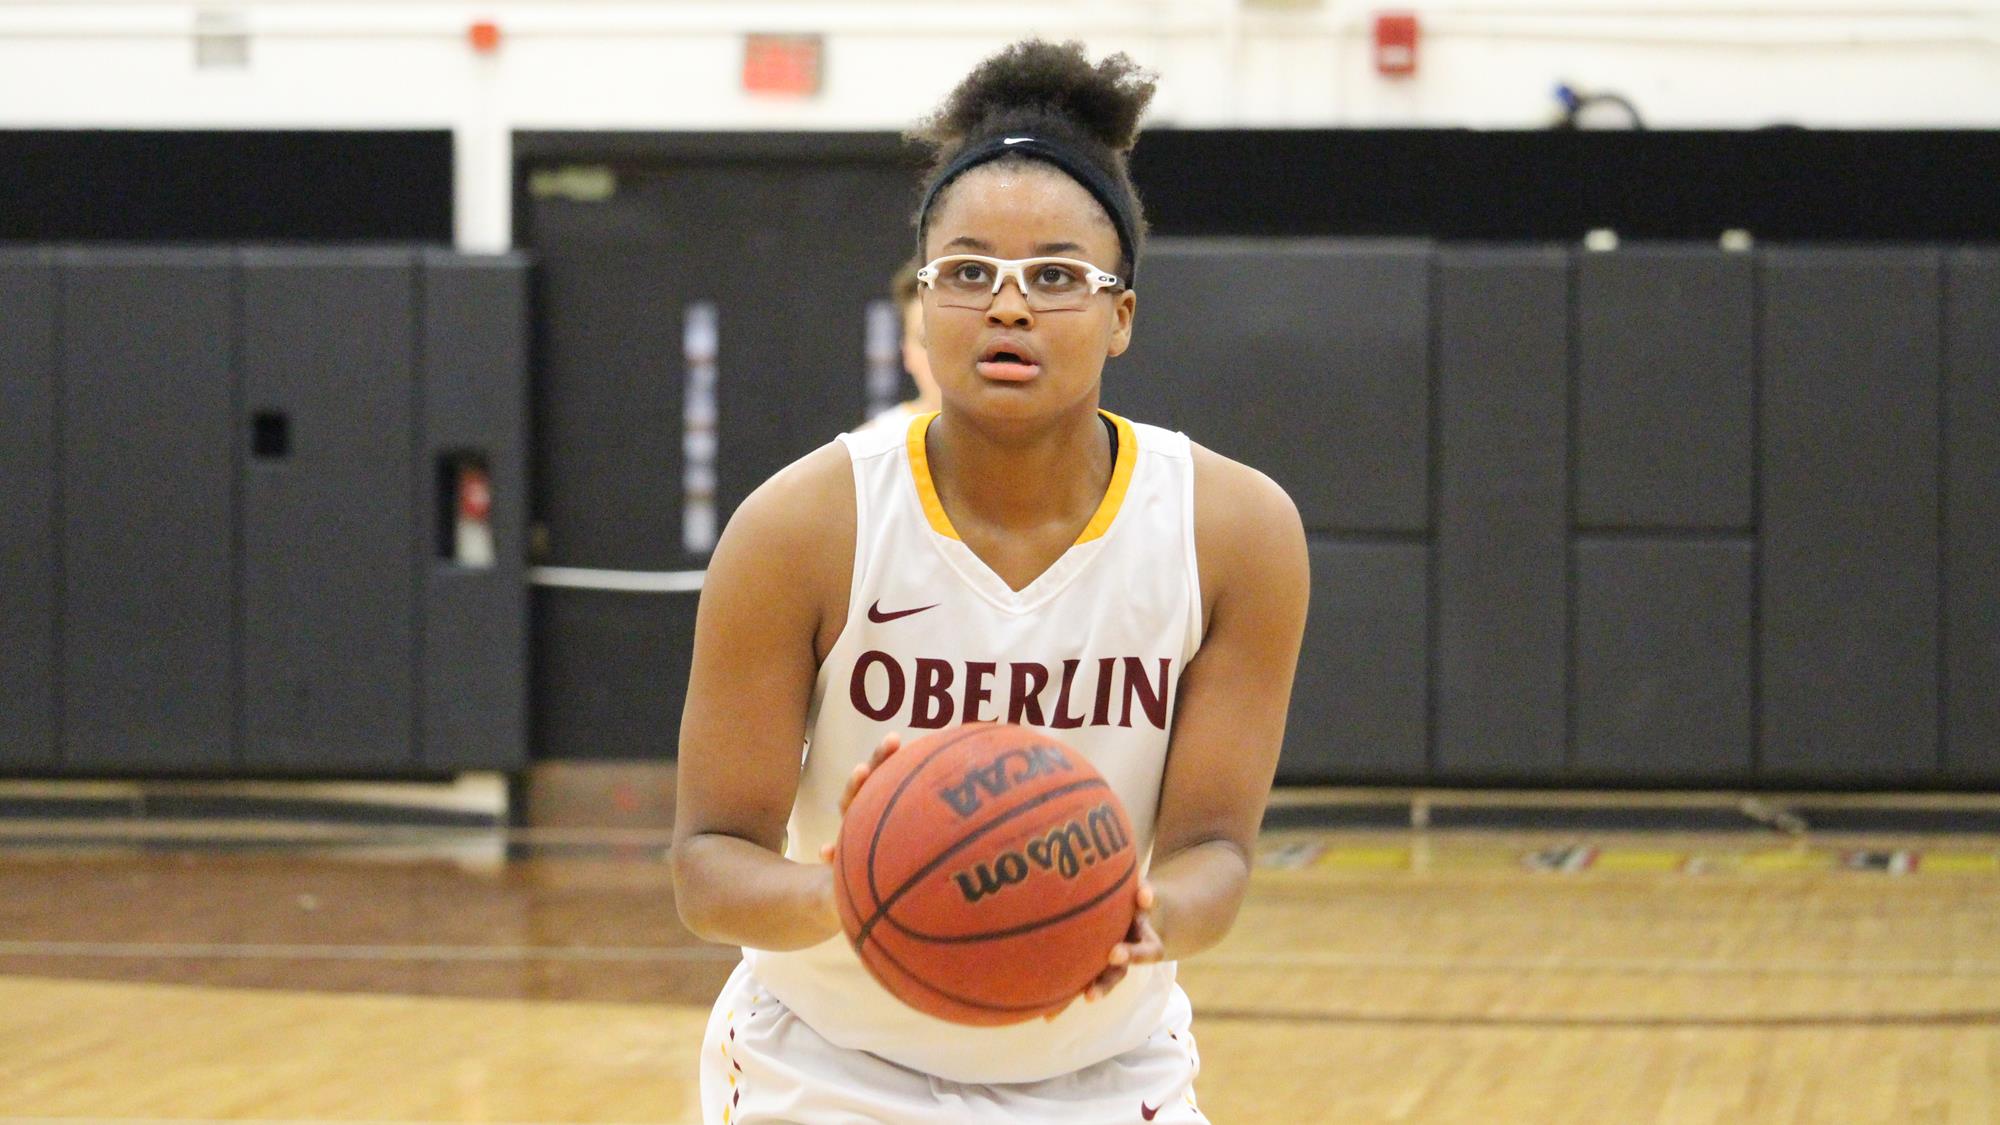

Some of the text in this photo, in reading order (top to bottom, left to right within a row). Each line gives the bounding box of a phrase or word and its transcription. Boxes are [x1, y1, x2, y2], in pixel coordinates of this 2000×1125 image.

[849, 650, 1172, 730] OBERLIN
[940, 744, 1073, 817] NCAA
[953, 804, 1130, 902] Wilson
